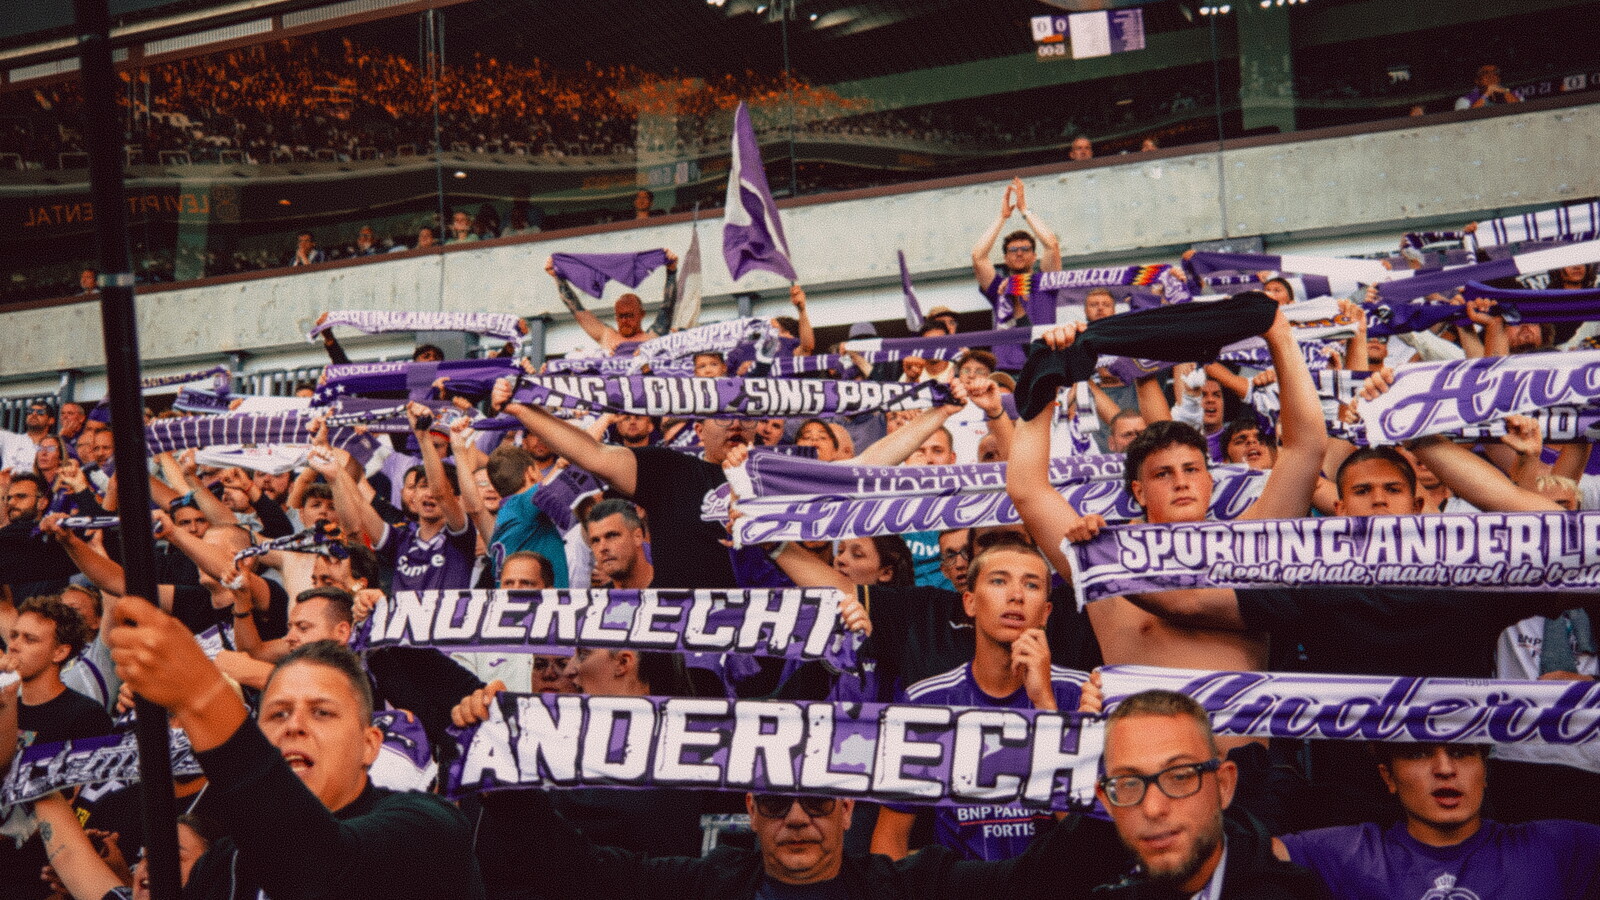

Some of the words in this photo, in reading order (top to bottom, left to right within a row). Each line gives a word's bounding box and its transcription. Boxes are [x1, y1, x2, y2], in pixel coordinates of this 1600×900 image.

[1040, 266, 1126, 290] ANDERLECHT
[326, 361, 405, 380] ANDERLECHT
[619, 377, 718, 415] LOUD
[744, 378, 824, 416] SING
[1121, 516, 1351, 572] SPORTING
[1210, 562, 1277, 583] Meest
[1376, 564, 1449, 584] maar
[1453, 563, 1503, 584] wel
[1507, 562, 1545, 584] de
[460, 695, 1105, 806] ANDERLECH
[957, 806, 992, 821] BNP
[982, 822, 1036, 838] FORTIS
